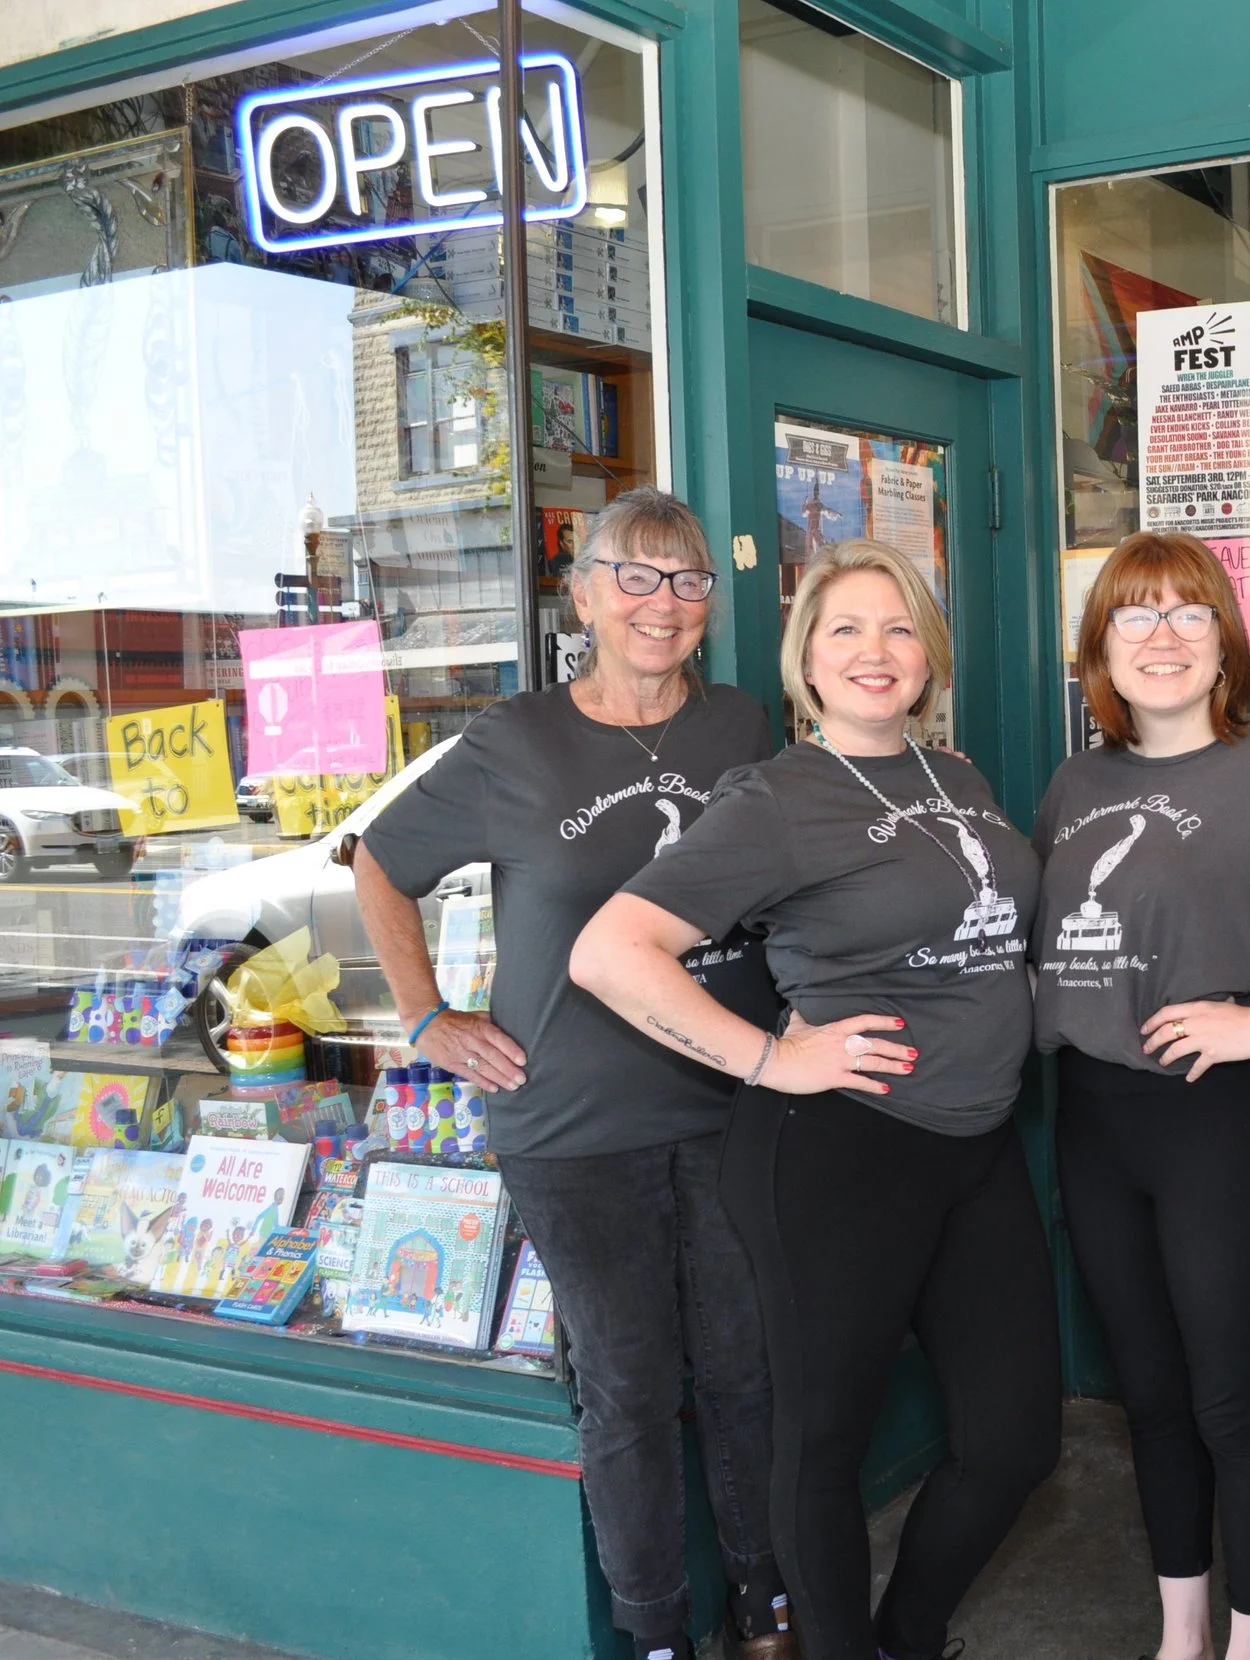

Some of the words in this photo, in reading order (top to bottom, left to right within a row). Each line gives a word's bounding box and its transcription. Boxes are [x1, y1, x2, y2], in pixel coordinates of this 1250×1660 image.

[257, 81, 569, 224] OPEN
[1173, 326, 1204, 347] AMP
[1174, 345, 1236, 371] FEST
[1177, 372, 1195, 382] WREN
[1196, 371, 1207, 381] THE
[1208, 370, 1234, 380] JUGGLER
[1181, 382, 1202, 392] ABBAS
[1206, 379, 1250, 390] DESPAIRPLANE
[1160, 394, 1171, 403] THE
[1172, 391, 1215, 402] ENTHUSIASTS
[1155, 404, 1169, 413] JAKE
[1170, 402, 1198, 412] NAVARRO
[1202, 400, 1220, 410] PEARL
[1151, 414, 1176, 423] NEESHA
[1176, 412, 1212, 422] BLANCHETT
[1217, 410, 1238, 419] RANDY
[1150, 425, 1166, 434] EVER
[1167, 423, 1190, 433] ENDING
[1191, 421, 1210, 431] KICKS
[1215, 420, 1240, 430] COLLINS
[1149, 433, 1186, 444] DESOLATION
[1187, 432, 1207, 441] SOUND
[1147, 444, 1169, 454] GRANT
[1169, 442, 1212, 453] FAIRBROTHER
[1217, 440, 1230, 449] DOG
[1146, 454, 1163, 464] YOUR
[1164, 453, 1183, 463] HEART
[1184, 452, 1208, 462] BREAKS
[1213, 451, 1225, 460] THE
[1225, 450, 1246, 459] YOUNG
[776, 463, 794, 479] UP
[797, 467, 816, 482] UP
[818, 470, 836, 485] UP
[1145, 465, 1157, 474] THE
[1200, 462, 1212, 471] THE
[1213, 460, 1232, 470] CHRIS
[881, 474, 899, 486] Fabric
[900, 478, 905, 487] &
[906, 478, 922, 489] Paper
[1162, 473, 1207, 485] SEPTEMBER
[1226, 471, 1247, 481] 12PM
[878, 487, 904, 501] Marbling
[905, 490, 926, 502] Classes
[1146, 492, 1195, 504] SEAFARERS'
[1208, 545, 1250, 570] AVE
[121, 705, 214, 771] Back
[140, 777, 190, 817] to
[304, 796, 362, 828] tim
[560, 776, 654, 840] Watermark
[657, 772, 712, 804] Book
[867, 800, 928, 844] Watmark
[1054, 796, 1142, 844] Watermark
[1140, 794, 1188, 821] Book
[685, 958, 699, 968] so
[702, 949, 725, 966] little
[939, 951, 969, 967] many
[1069, 956, 1099, 971] books,
[1101, 961, 1112, 970] so
[1057, 977, 1102, 989] Anacortes,
[207, 1111, 259, 1130] Rainbow
[216, 1155, 237, 1177] All
[237, 1158, 264, 1179] Are
[202, 1177, 267, 1204] Welcome
[374, 1169, 401, 1188] THIS
[407, 1173, 420, 1189] IS
[426, 1176, 434, 1191] A
[441, 1175, 490, 1197] SCHOOL
[15, 1215, 37, 1227] Meet
[38, 1221, 44, 1230] a
[6, 1230, 48, 1243] Librarian!
[267, 1235, 316, 1251] Alphabet
[275, 1247, 304, 1259] Phonics
